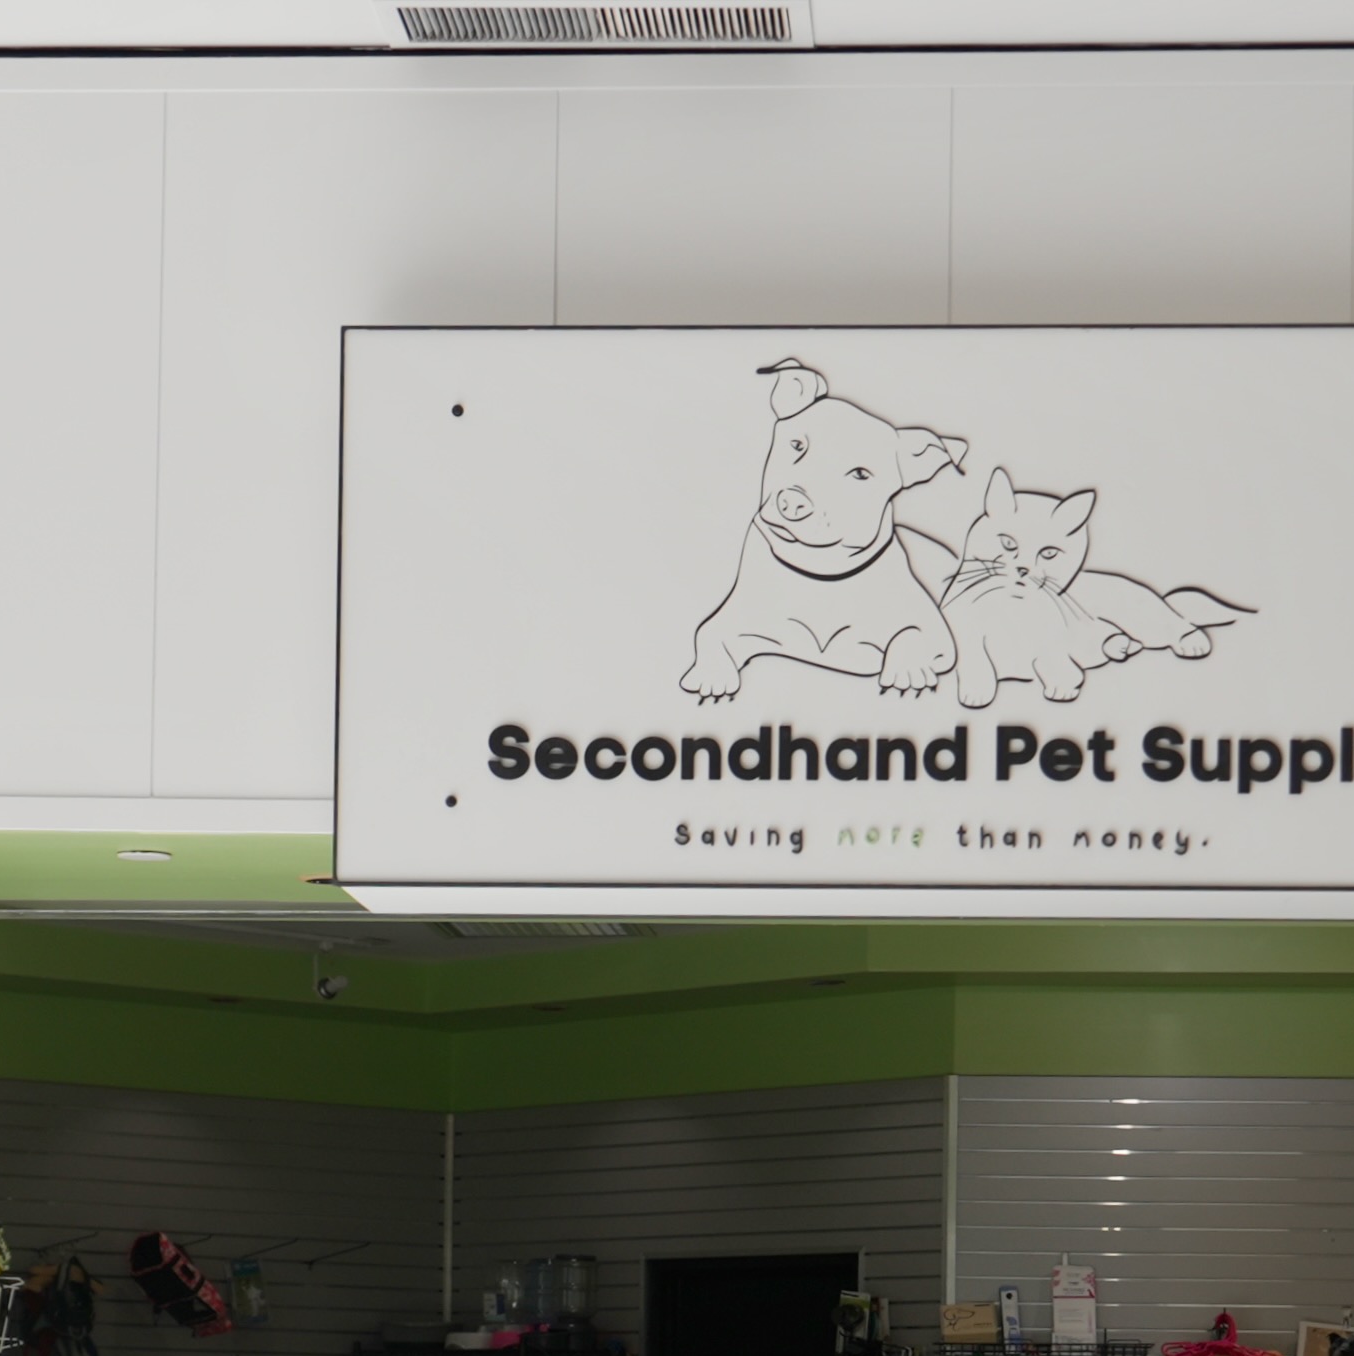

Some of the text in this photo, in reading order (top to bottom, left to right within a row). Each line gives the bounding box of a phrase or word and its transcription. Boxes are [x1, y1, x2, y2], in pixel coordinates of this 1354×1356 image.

[487, 723, 969, 784] Secondhand
[994, 724, 1116, 784] Pet
[674, 823, 806, 857] Saving
[956, 824, 1044, 850] than
